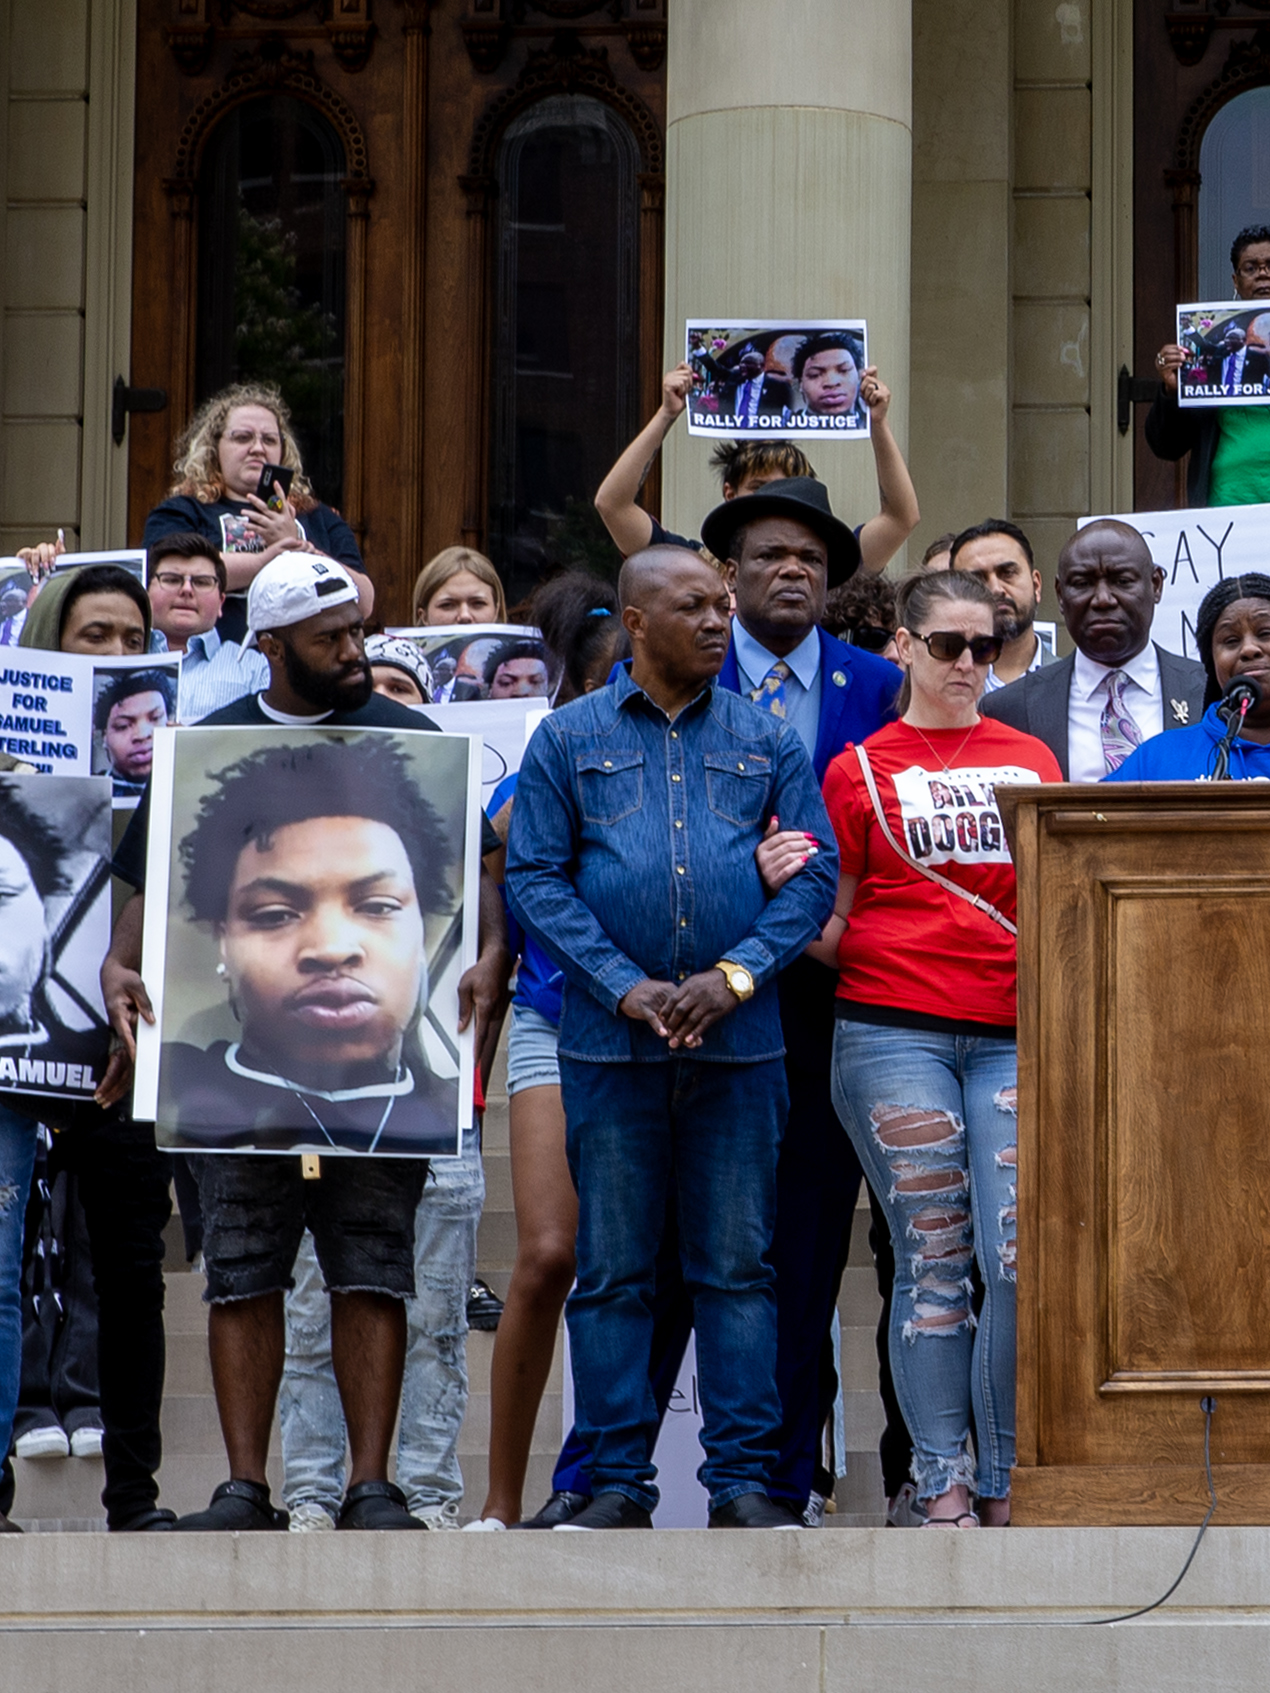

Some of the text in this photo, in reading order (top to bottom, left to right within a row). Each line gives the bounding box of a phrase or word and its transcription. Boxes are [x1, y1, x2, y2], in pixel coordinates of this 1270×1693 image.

[1184, 384, 1230, 397] RALLY
[1233, 383, 1264, 396] FOR
[693, 413, 858, 428] RALLY FOR JUSTICE
[0, 668, 73, 693] JUSTICE
[12, 692, 48, 713] FOR
[0, 736, 78, 759] TERLING
[908, 811, 1008, 859] DOGG
[0, 1056, 97, 1090] AMUEL
